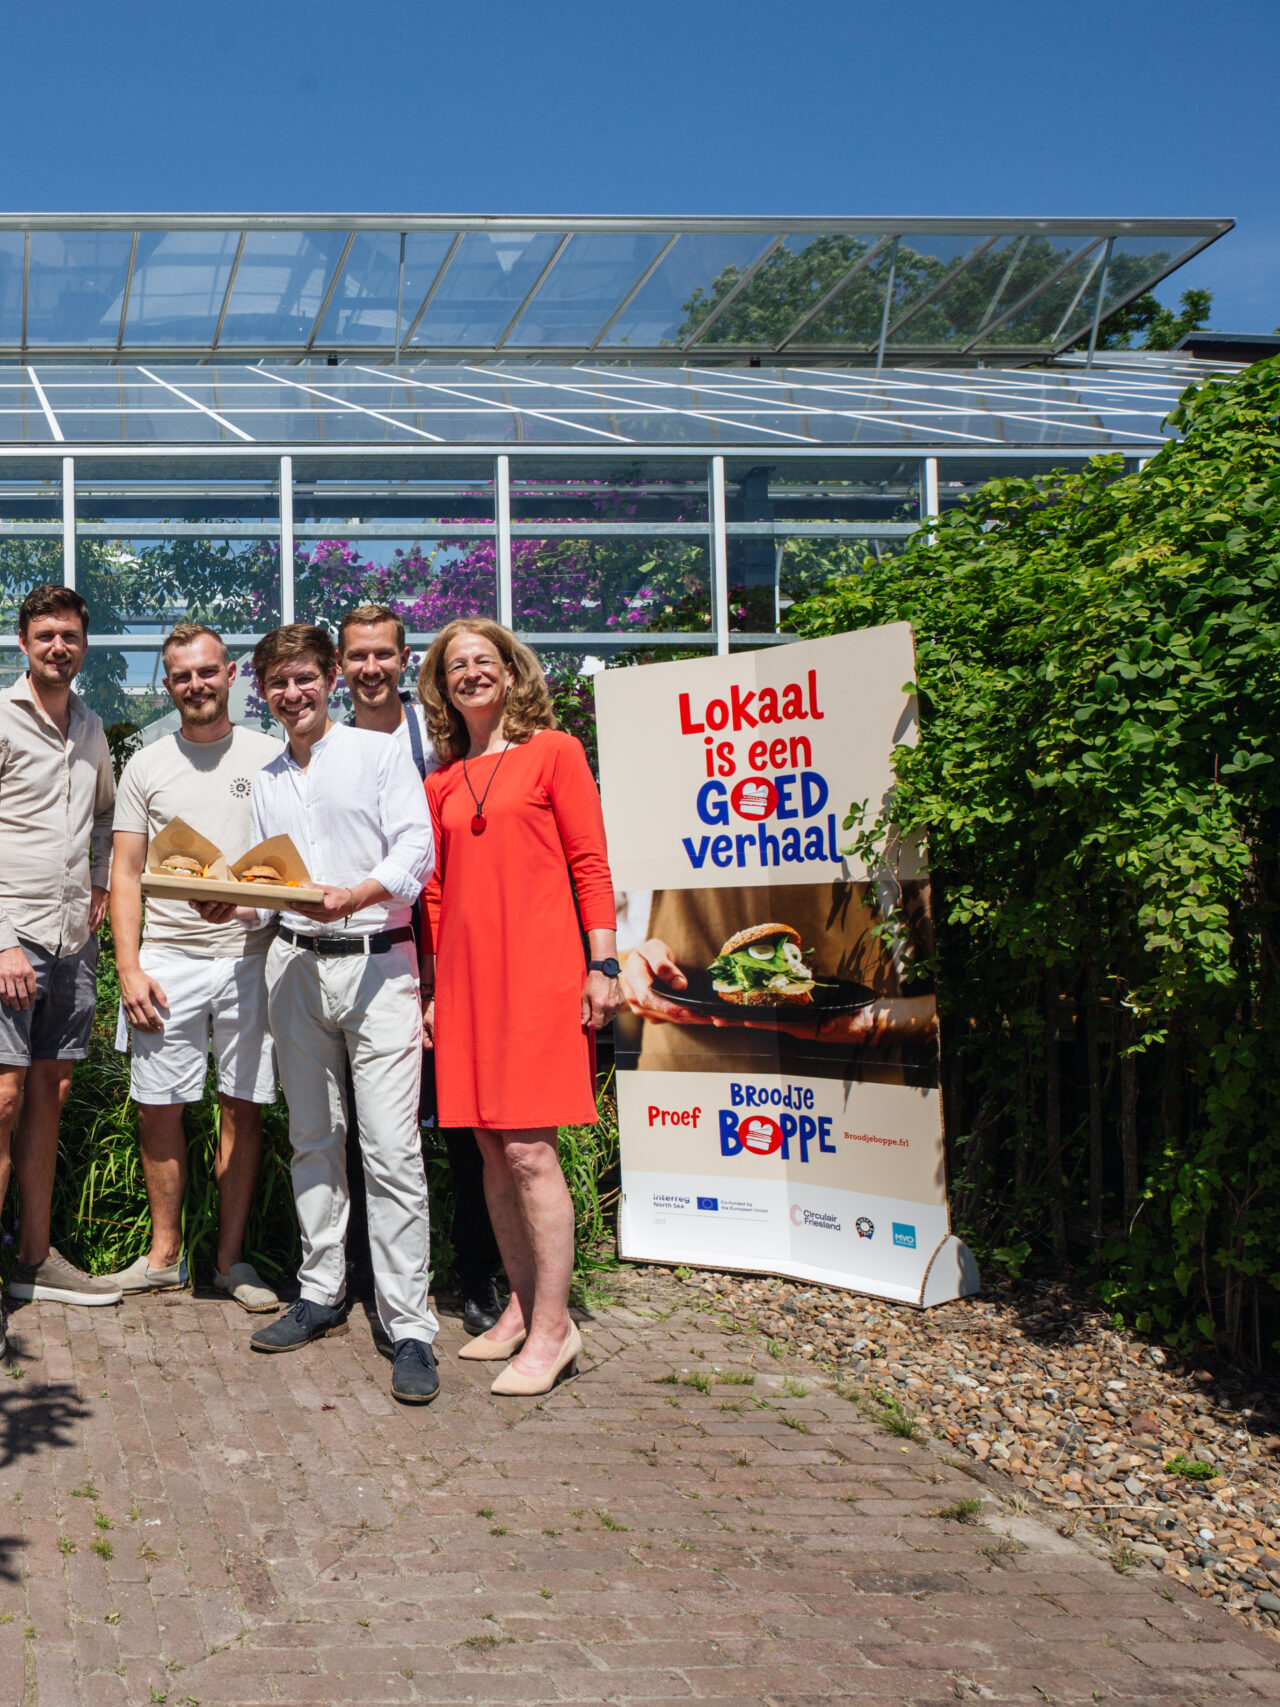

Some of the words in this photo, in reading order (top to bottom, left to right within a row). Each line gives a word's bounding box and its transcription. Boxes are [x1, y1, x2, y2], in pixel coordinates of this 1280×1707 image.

[678, 669, 824, 735] Lokaal
[704, 736, 736, 777] is
[748, 735, 812, 772] een
[682, 813, 843, 869] verhaal
[648, 1106, 702, 1128] Proef
[843, 1131, 909, 1147] Broodjeboppe.frl
[803, 1209, 837, 1222] Circulair
[804, 1217, 841, 1231] Friesland
